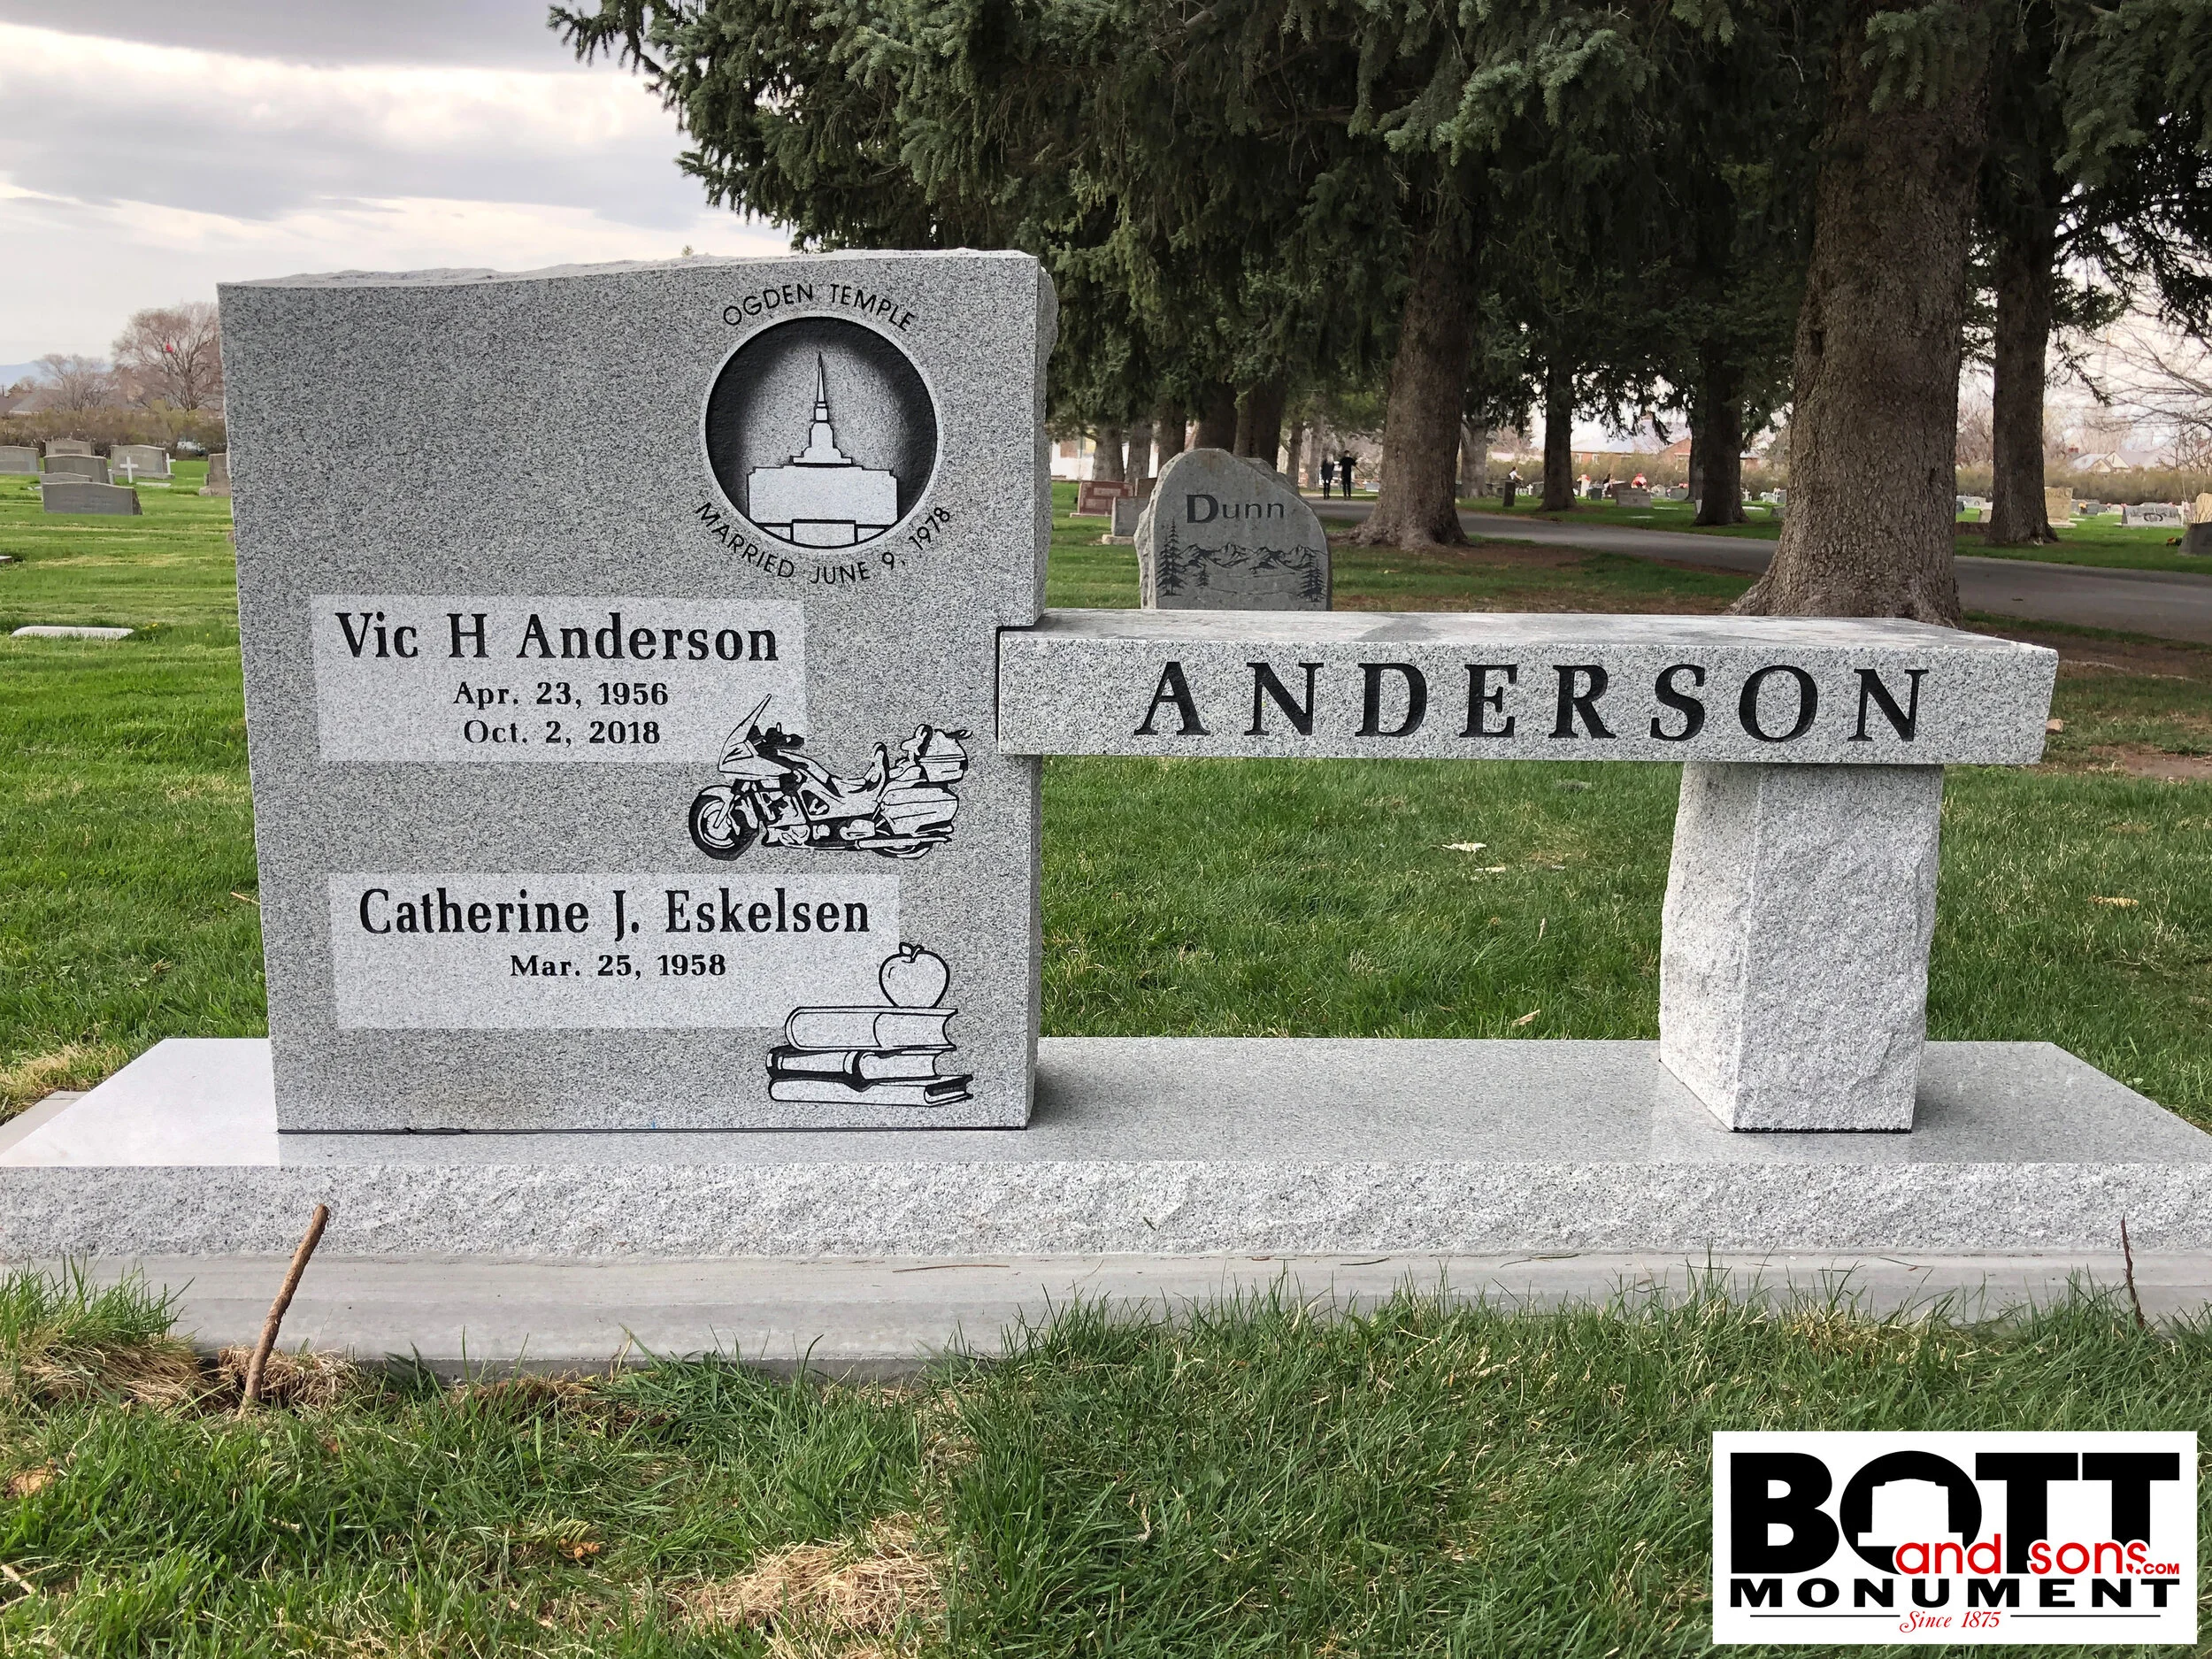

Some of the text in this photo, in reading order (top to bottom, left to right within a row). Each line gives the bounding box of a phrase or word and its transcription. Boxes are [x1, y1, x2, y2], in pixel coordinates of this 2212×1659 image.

[723, 283, 915, 332] OGDEN TEMPLE
[1186, 494, 1285, 524] Dunn
[695, 502, 951, 585] MARRIED JUNE 9, 1978
[334, 611, 779, 661] Vic H Anderson
[453, 681, 669, 710] Apr. 23, 1956
[1133, 661, 1929, 743] ANDERSON
[463, 719, 661, 746] Oct. 2, 2018
[358, 887, 871, 942] Catherine J. Eskelsen
[510, 954, 726, 979] Mar. 25, 1958
